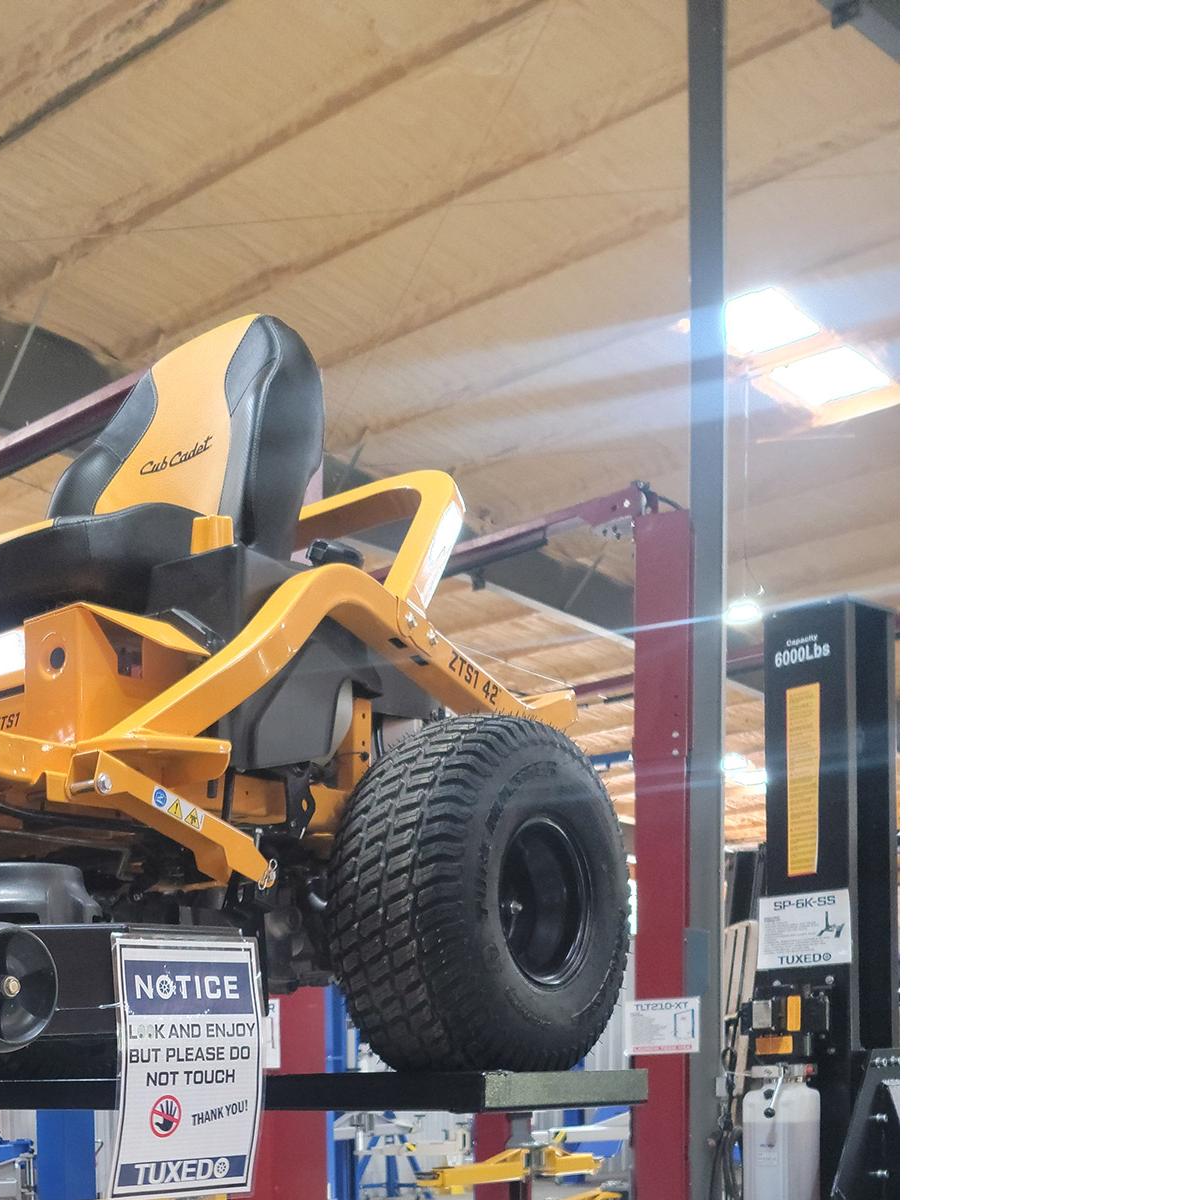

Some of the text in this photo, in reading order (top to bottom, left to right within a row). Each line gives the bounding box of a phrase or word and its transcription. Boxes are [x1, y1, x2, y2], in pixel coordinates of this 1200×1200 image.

[140, 433, 213, 475] Cub Cadet
[775, 642, 831, 668] 6000Lbs
[449, 650, 480, 689] ZTS1
[773, 895, 836, 911] SP-6K-SS
[134, 974, 240, 1000] NOTICE
[168, 1023, 202, 1039] AND
[206, 1022, 256, 1038] ENJOY
[128, 1045, 251, 1064] BUT PLEASE DO
[146, 1069, 236, 1087] NOT TOUCH
[191, 1099, 249, 1127] THANK YOU!
[134, 1157, 231, 1186] TUXEDO
